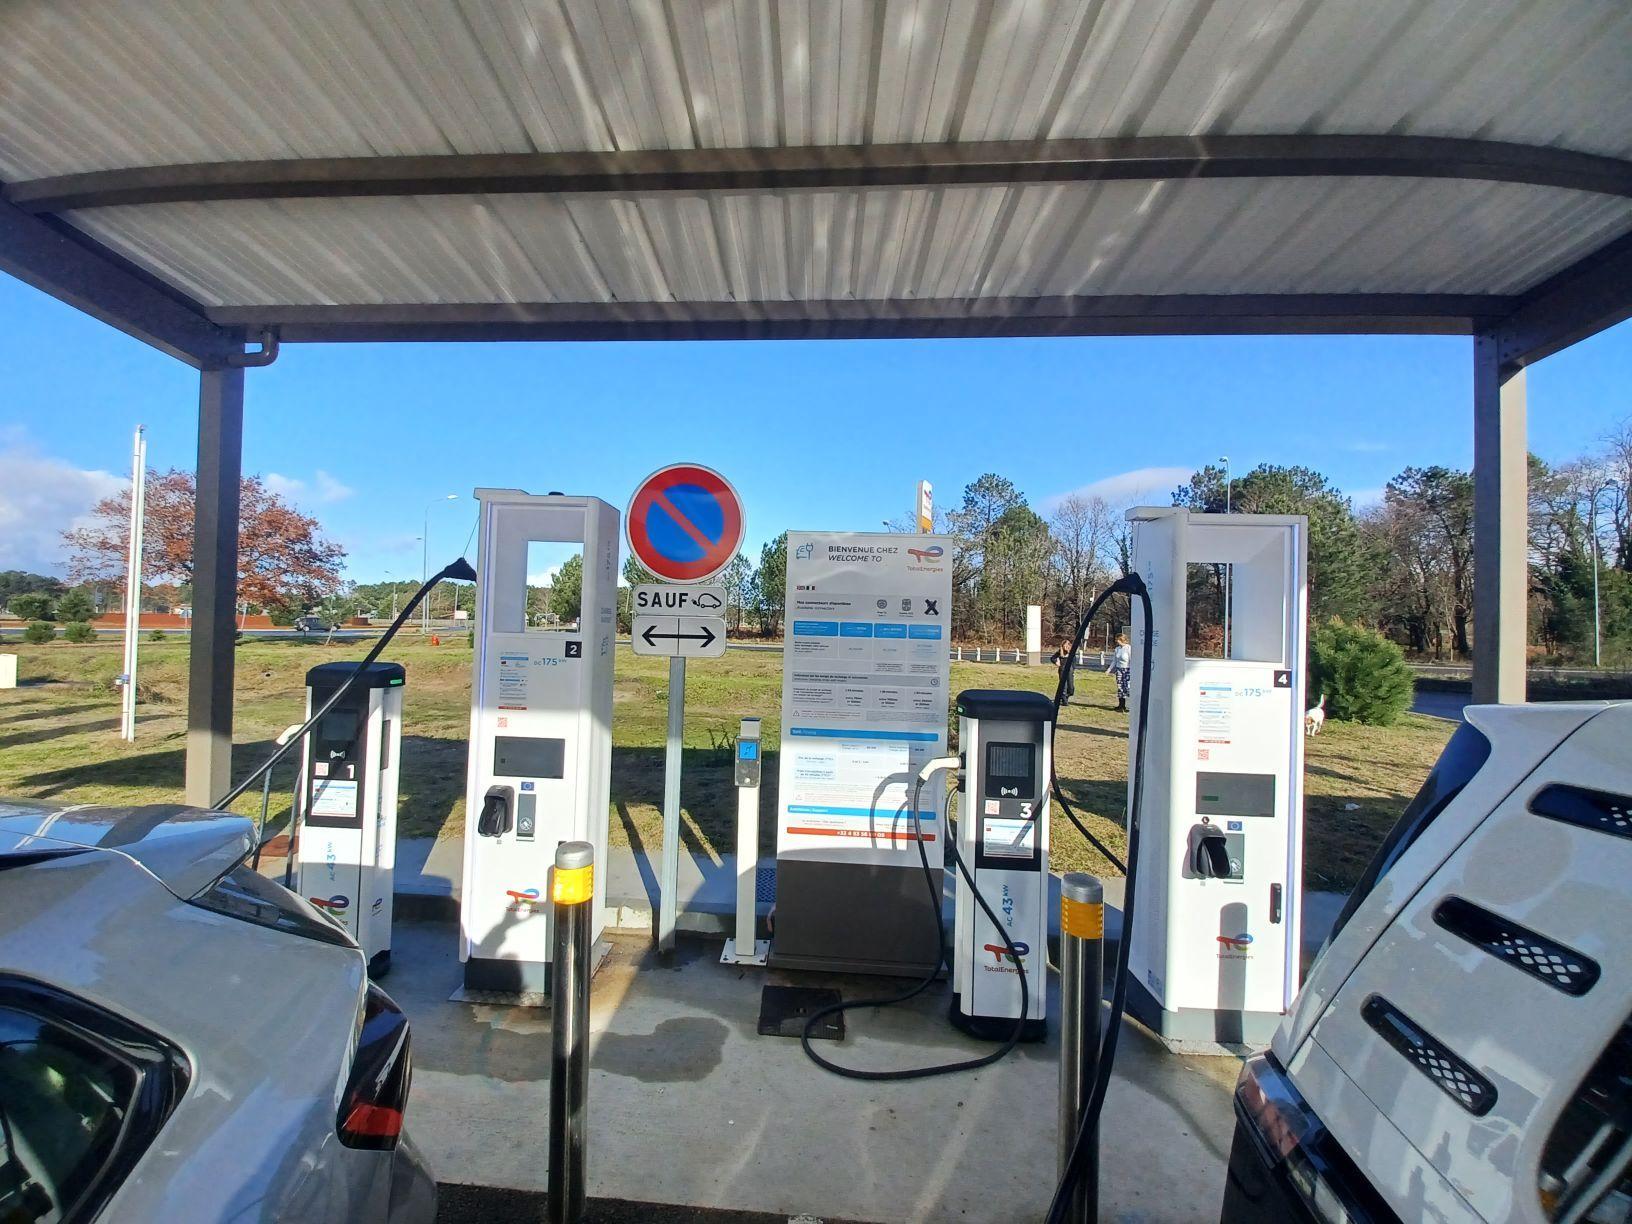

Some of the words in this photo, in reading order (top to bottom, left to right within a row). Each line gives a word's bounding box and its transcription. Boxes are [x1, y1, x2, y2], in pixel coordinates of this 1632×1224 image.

[828, 545, 875, 554] BIENVENUE
[876, 546, 899, 554] CHEZ
[828, 554, 869, 562] WELCOME
[906, 565, 944, 573] TotalEnergies
[637, 591, 689, 608] SAUF
[570, 645, 578, 655] 2
[542, 657, 558, 666] 175
[1278, 674, 1288, 685] 4
[1244, 688, 1262, 697] 175
[346, 764, 355, 779] 1
[1019, 802, 1032, 818] 3
[327, 853, 336, 870] 43
[1002, 884, 1009, 897] kW
[1002, 898, 1014, 916] 43
[1006, 917, 1013, 927] AC
